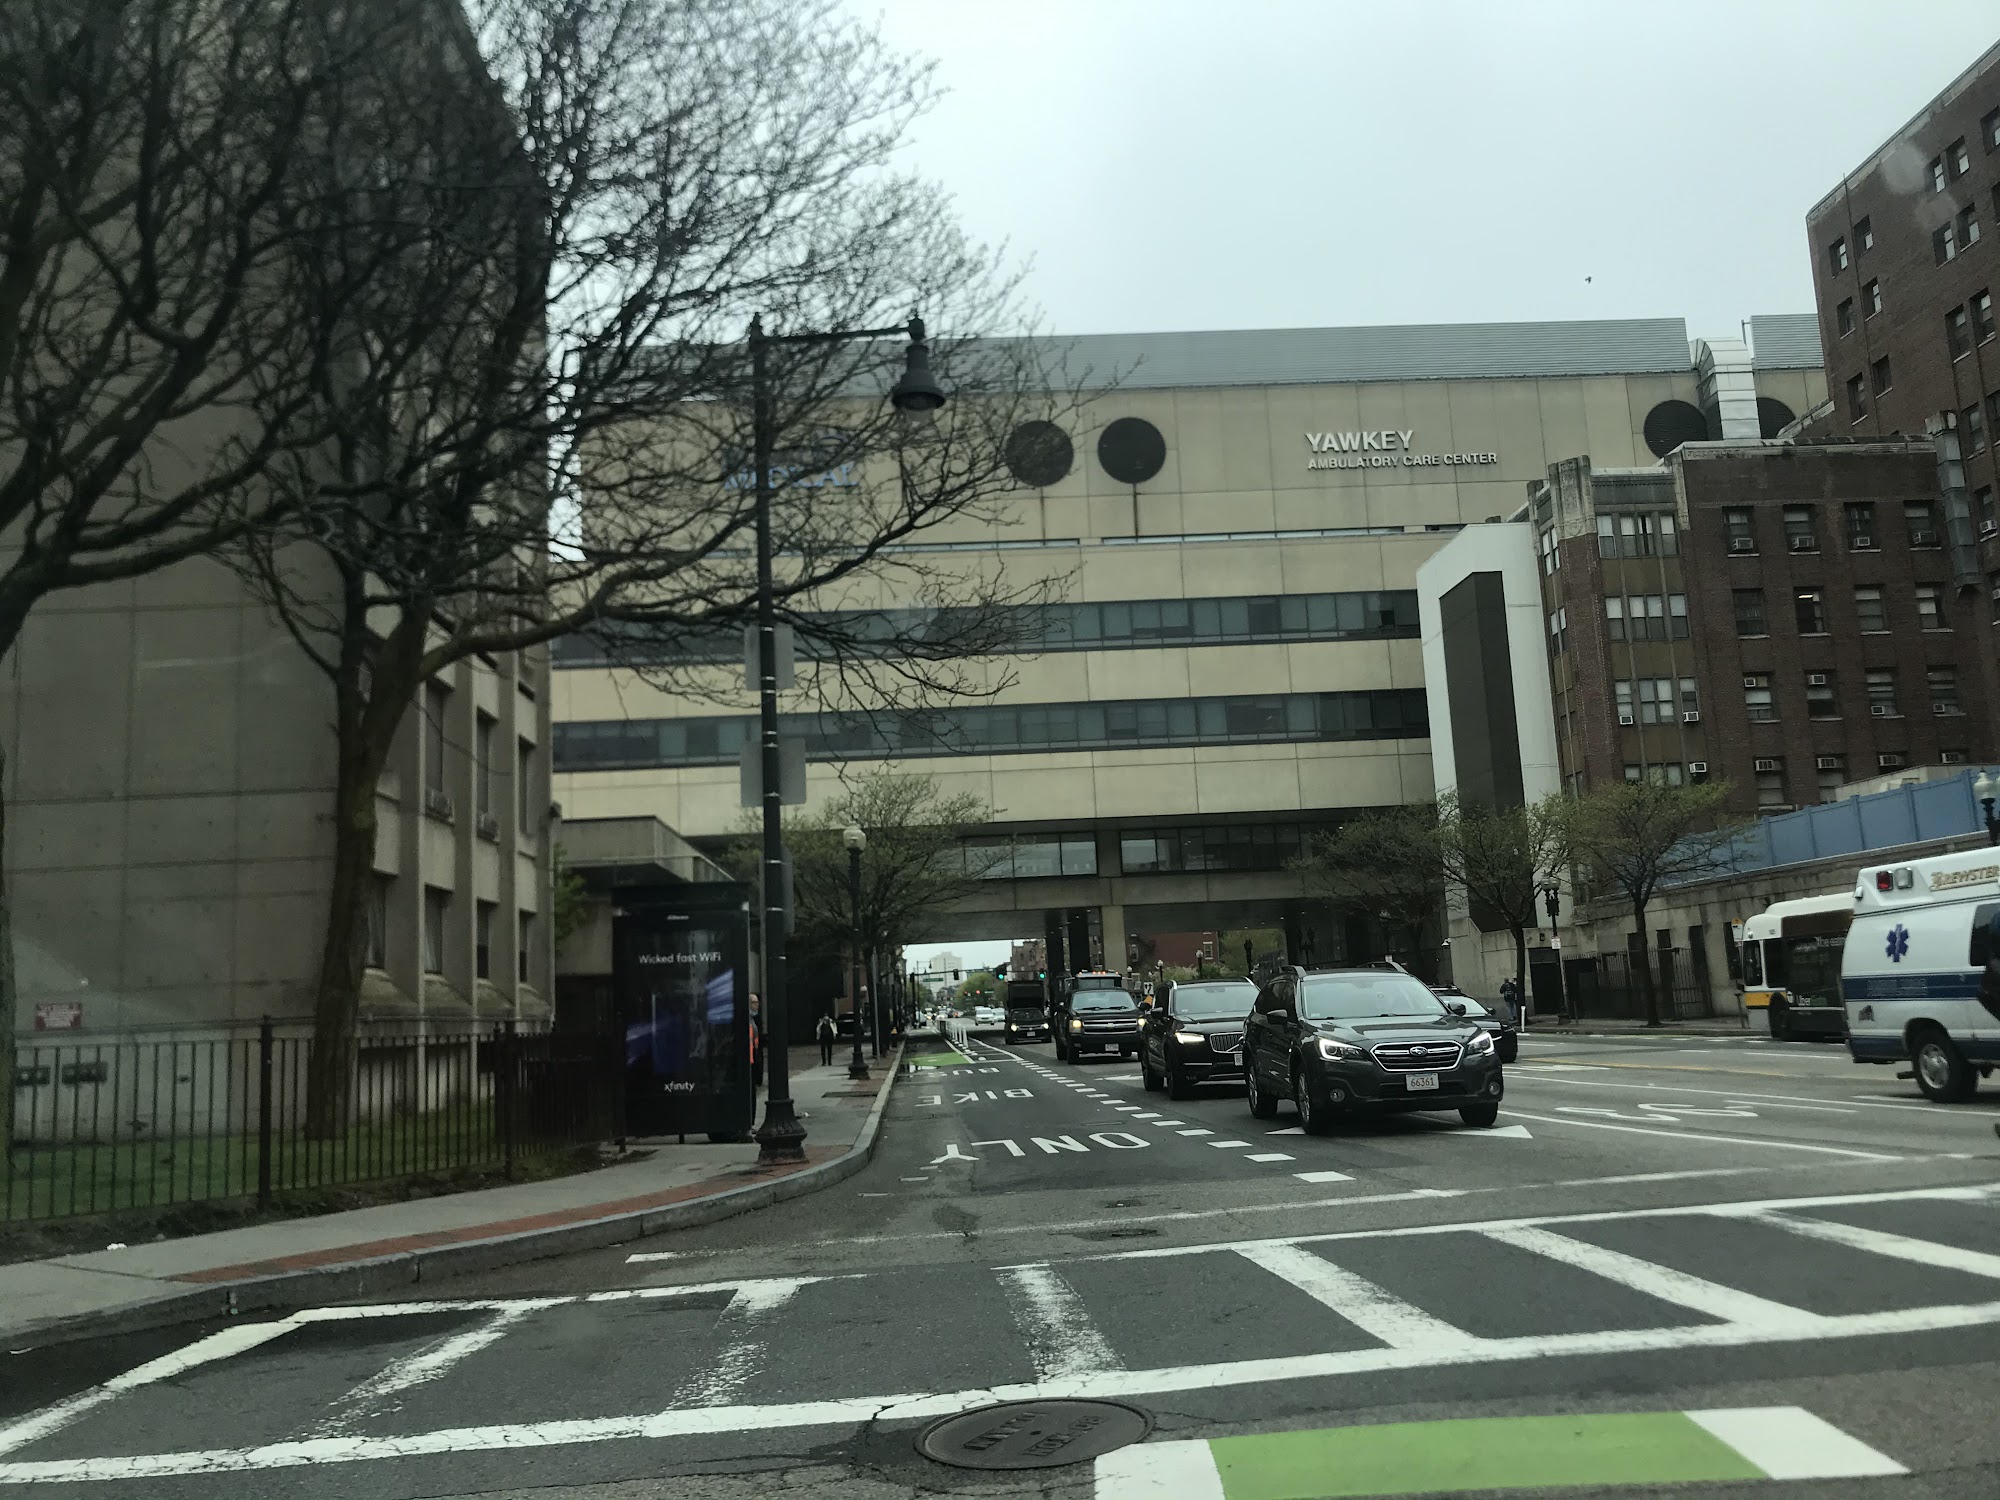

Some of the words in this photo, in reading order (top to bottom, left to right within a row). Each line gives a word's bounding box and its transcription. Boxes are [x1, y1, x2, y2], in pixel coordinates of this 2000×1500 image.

[1305, 430, 1414, 452] YAWKEY
[1307, 456, 1399, 470] AMBULATORY
[1403, 454, 1440, 467] CARE
[1443, 452, 1498, 466] CENTER
[638, 954, 674, 965] Wicked
[676, 953, 697, 964] fast
[699, 951, 721, 963] WiFi
[664, 1081, 695, 1092] xfinity
[1410, 1077, 1435, 1087] 66361
[915, 1087, 1034, 1107] BIKE
[929, 1132, 1151, 1164] ONLY
